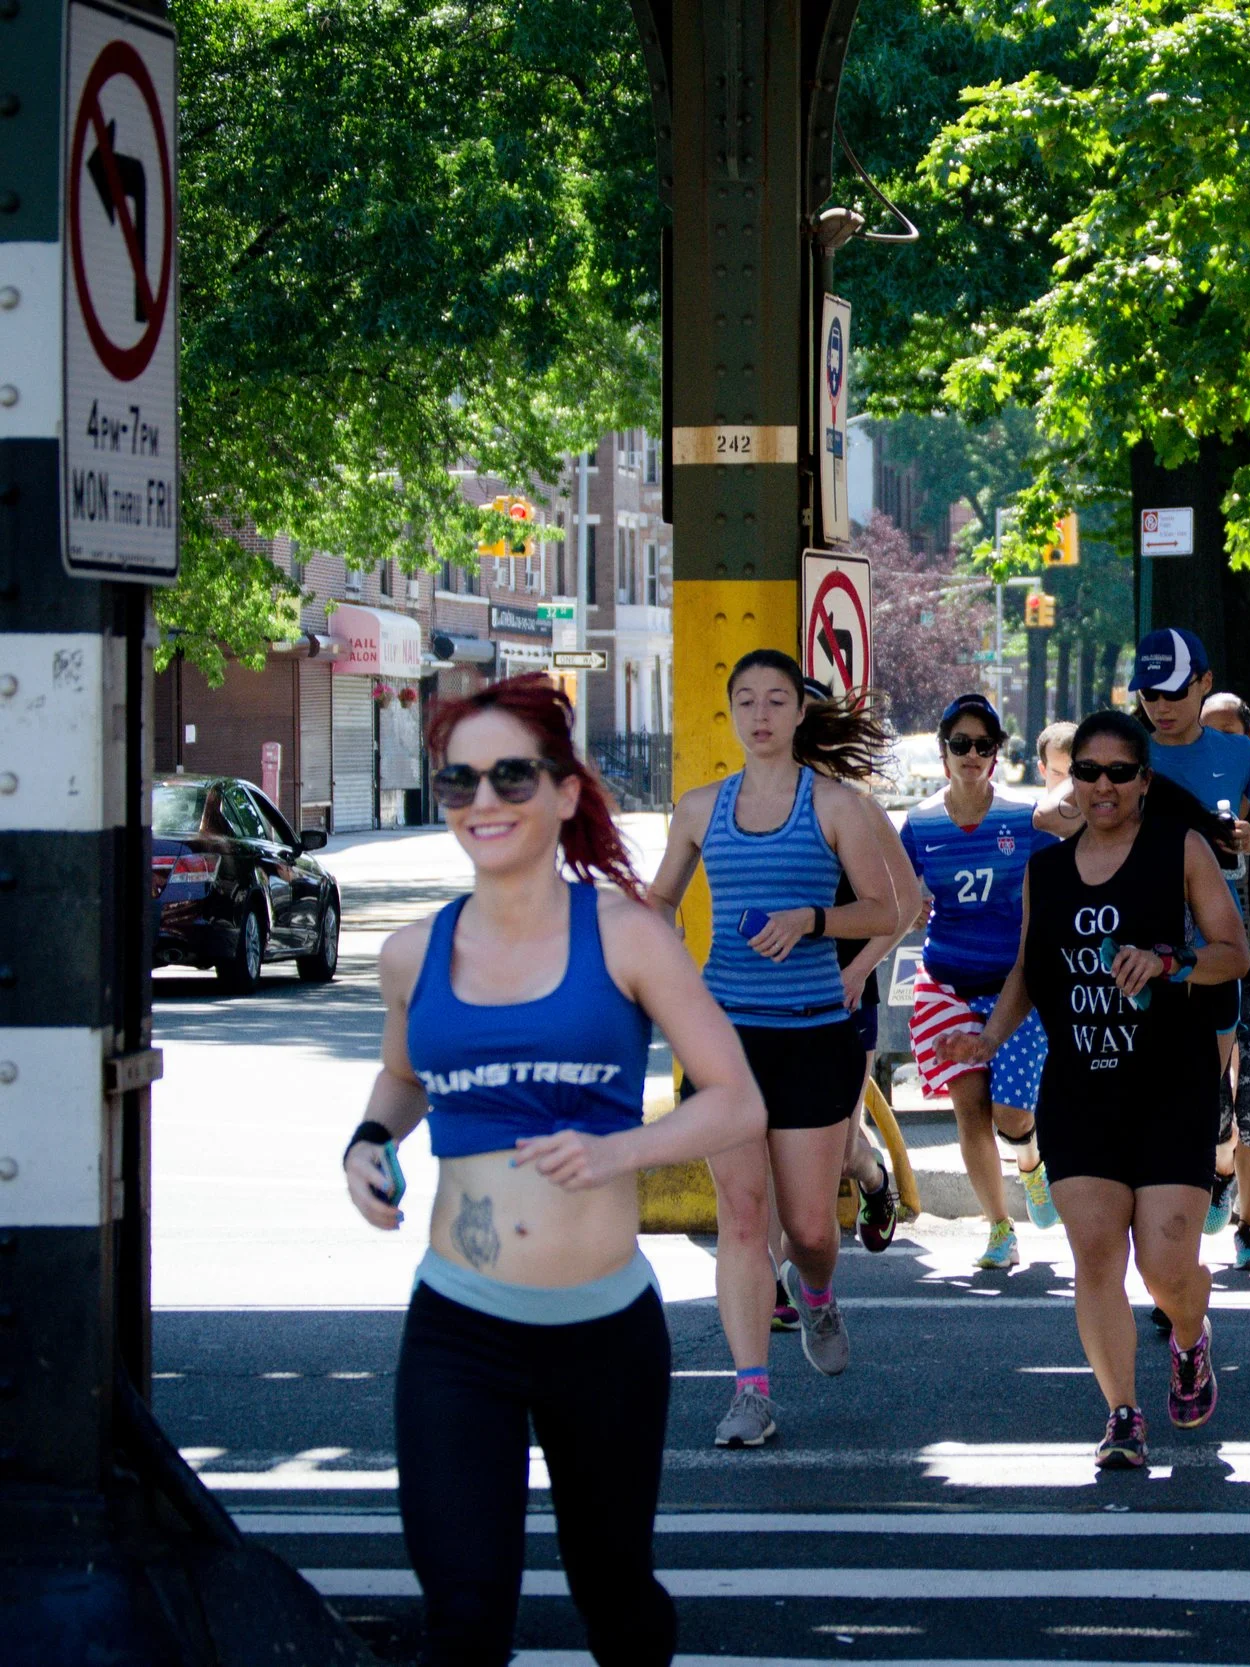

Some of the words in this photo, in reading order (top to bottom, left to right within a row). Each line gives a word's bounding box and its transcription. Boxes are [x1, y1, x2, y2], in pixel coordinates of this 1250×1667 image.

[717, 434, 751, 453] 242
[72, 468, 109, 522] MON
[113, 489, 142, 526] THRU
[147, 478, 172, 529] FRI
[546, 607, 557, 618] 32
[349, 638, 377, 649] AIL
[349, 651, 377, 662] ALON
[560, 656, 575, 664] ONE
[582, 656, 598, 664] WAY
[954, 867, 994, 904] 27
[1074, 905, 1120, 936] GO
[1072, 1024, 1139, 1054] WAY
